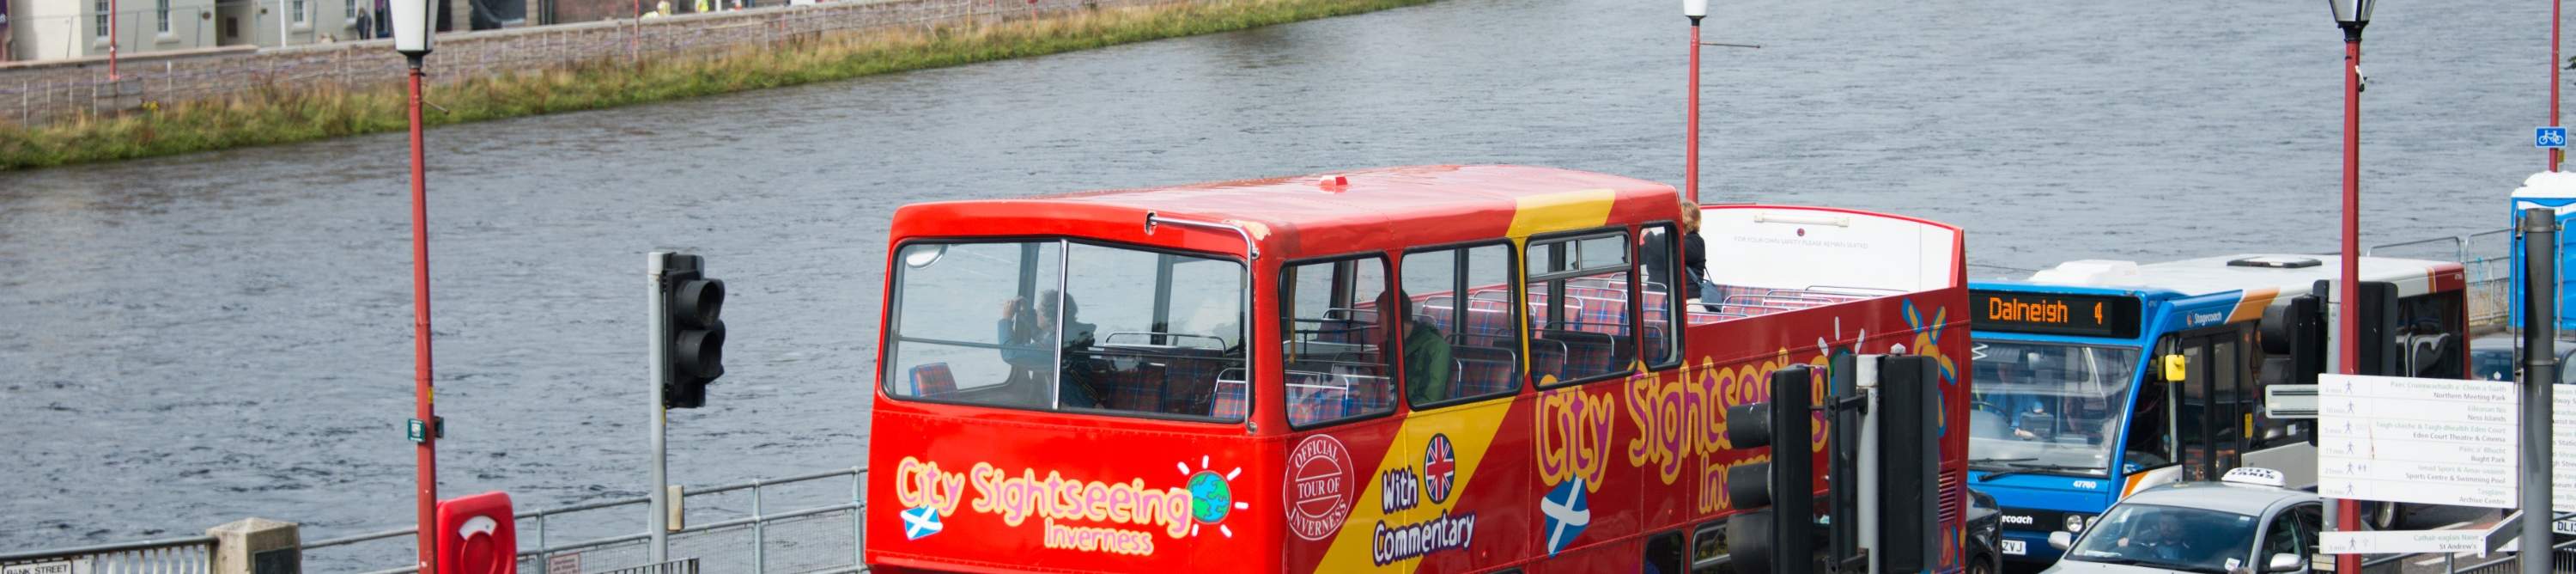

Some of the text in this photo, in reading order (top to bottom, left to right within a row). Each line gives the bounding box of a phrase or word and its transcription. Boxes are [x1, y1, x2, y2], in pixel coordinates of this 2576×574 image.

[1989, 297, 2103, 325] Dalneigh 4
[2433, 392, 2462, 400] Northern
[2464, 393, 2490, 402] Meeting
[1536, 373, 1615, 493] City
[2430, 432, 2448, 441] Court
[2450, 433, 2474, 442] Theatre
[1295, 438, 1340, 469] OFFICIAL
[2470, 455, 2490, 464] Bught
[1297, 476, 1341, 498] TOUR OF
[1381, 465, 1419, 516] With
[2405, 473, 2426, 481] Sports
[2456, 474, 2489, 485] Swimming
[2491, 476, 2506, 485] Pool
[896, 455, 1193, 538] City Sightseeing
[2459, 496, 2482, 504] Archive
[1289, 498, 1347, 537] INVERNESS
[2002, 515, 2033, 526] ecoach
[1044, 516, 1154, 556] Inverness
[1373, 509, 1477, 567] Commentary
[34, 564, 68, 574] STREET
